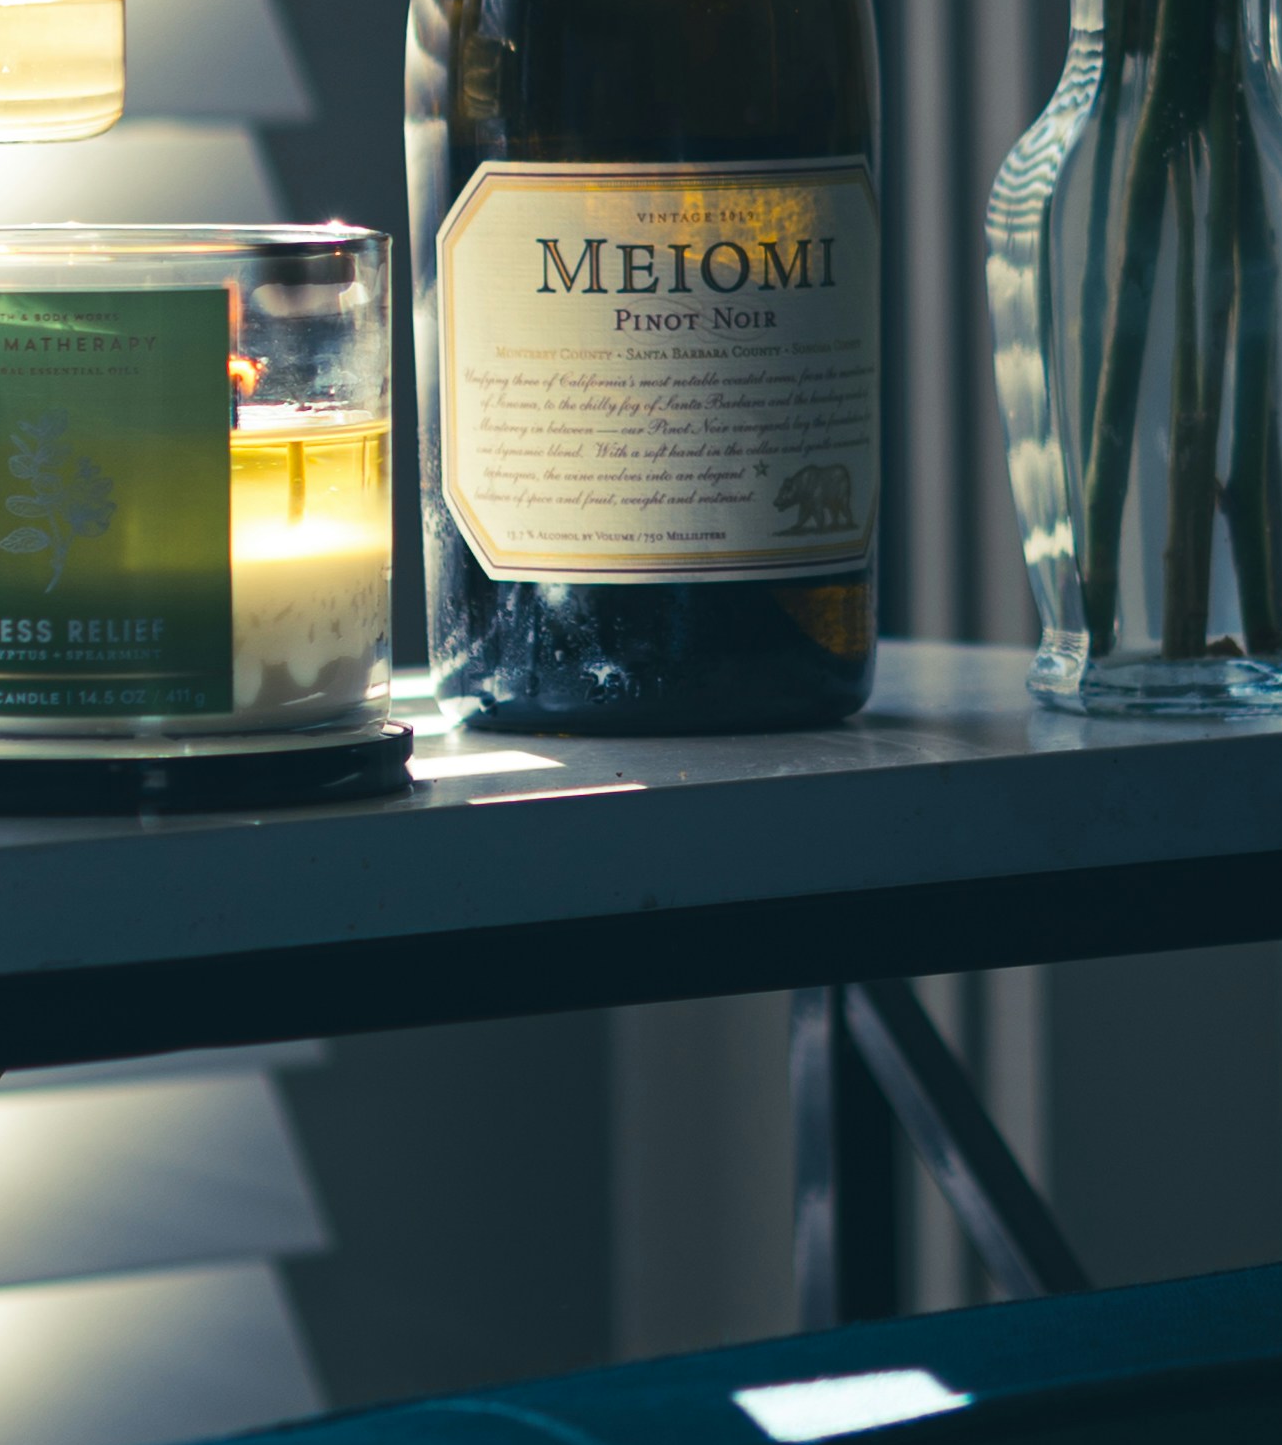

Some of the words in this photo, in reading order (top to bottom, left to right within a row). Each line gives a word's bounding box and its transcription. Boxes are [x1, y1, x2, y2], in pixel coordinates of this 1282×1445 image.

[636, 212, 712, 223] VINTAGE
[720, 211, 754, 222] 2019
[536, 238, 836, 293] MEIOMI
[20, 313, 28, 322] &
[34, 313, 68, 322] BODY
[74, 313, 120, 322] WORKS
[614, 309, 700, 331] PINOT
[712, 307, 777, 329] NOIR
[495, 346, 557, 360] MONTEREY
[560, 347, 612, 360] COUNTY
[626, 347, 668, 360] SANTA
[672, 347, 729, 360] BARBARA
[731, 345, 780, 358] COUNTY
[29, 366, 104, 376] ESSENTIAL
[107, 366, 140, 376] OILS
[542, 372, 560, 392] of
[560, 371, 635, 392] California's
[639, 375, 671, 387] most
[672, 371, 719, 388] notable
[544, 399, 555, 410] to
[558, 396, 577, 410] the
[579, 395, 617, 417] chilly
[617, 395, 640, 417] fog
[643, 395, 662, 416] of
[659, 394, 702, 410] Santa
[704, 393, 765, 410] Barbara
[531, 423, 543, 434] in
[546, 420, 594, 434] between
[621, 426, 644, 435] our
[647, 418, 691, 435] Pinot
[691, 417, 729, 435] Noir
[594, 442, 628, 458] With
[630, 450, 640, 458] a
[643, 442, 667, 463] soft
[667, 443, 707, 458] hand
[706, 445, 721, 457] in
[724, 442, 743, 457] the
[543, 467, 561, 480] the
[564, 471, 594, 481] wine
[597, 467, 642, 481] evolves
[645, 469, 673, 482] into
[675, 473, 694, 482] an
[697, 466, 746, 486] elegant
[555, 490, 583, 504] and
[581, 490, 617, 510] fruit,
[620, 491, 666, 512] weight
[666, 489, 697, 504] and
[536, 530, 580, 541] ALCOHOL
[593, 530, 635, 542] VOLUME
[643, 532, 663, 543] 750
[666, 530, 726, 541] MILLILITERS
[67, 617, 164, 643] RELIEF
[65, 648, 162, 661] SPEARMINT
[78, 689, 115, 705] 14.5
[120, 689, 147, 704] OZ
[165, 688, 190, 703] 411
[194, 691, 206, 707] g
